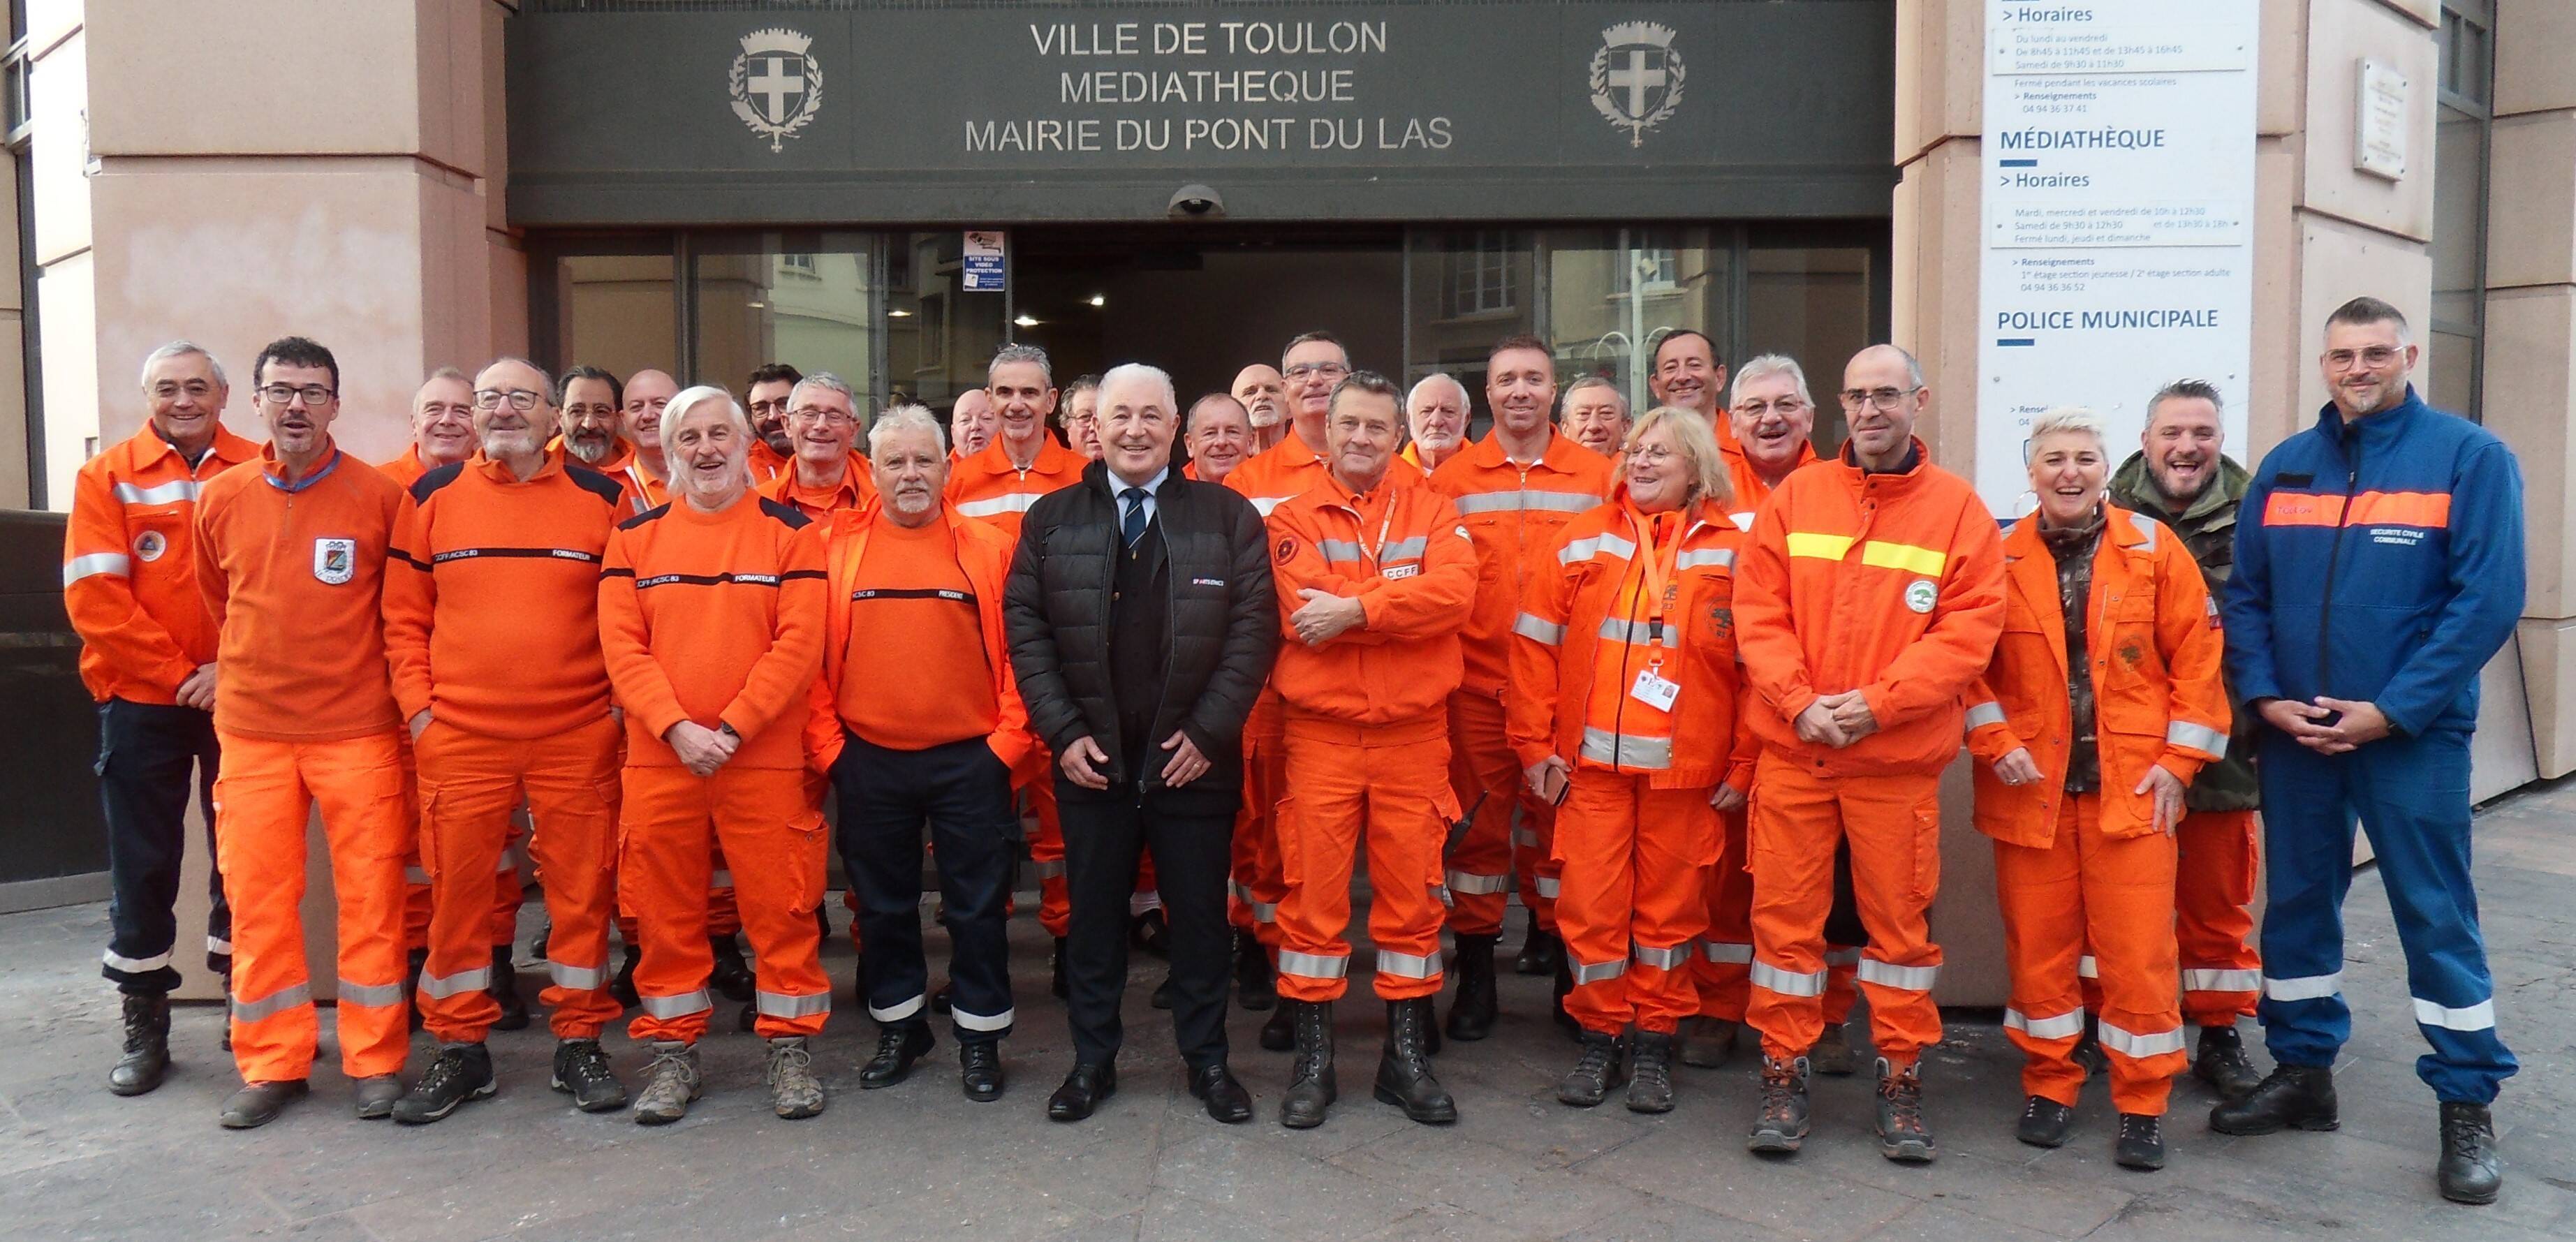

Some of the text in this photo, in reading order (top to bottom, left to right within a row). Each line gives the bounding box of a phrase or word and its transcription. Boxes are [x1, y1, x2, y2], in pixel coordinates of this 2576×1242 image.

[2019, 6, 2093, 22] Horaires
[1030, 22, 1386, 55] VILLE DE TOULON
[2016, 35, 2028, 43] Du
[2069, 34, 2107, 43] vendredi
[2105, 47, 2115, 55] de
[2118, 46, 2145, 54] 13h45
[2156, 45, 2183, 54] 16h45
[2016, 61, 2048, 69] Samedi
[2064, 60, 2086, 68] 9h30
[1061, 71, 1355, 103] MEDIATHEQUE
[2045, 79, 2081, 88] pendant
[2024, 92, 2096, 101] Renseignements
[966, 117, 1452, 151] MAIRIE DU PONT DU LAS
[2001, 126, 2165, 150] MÉDIATHÈQUE
[2017, 172, 2089, 187] Horaires
[2100, 208, 2136, 216] vendredi
[2140, 207, 2151, 216] de
[2154, 207, 2171, 216] 10h
[2180, 207, 2205, 216] 12h30
[2015, 221, 2047, 230] Samedi
[2096, 221, 2123, 229] 12h30
[2045, 235, 2069, 243] lundi,
[2072, 235, 2094, 244] jeudi
[2022, 258, 2095, 267] Renseignements
[2034, 271, 2057, 280] étage
[2060, 270, 2089, 279] section
[2091, 270, 2128, 280] jeunesse
[2147, 269, 2170, 279] étage
[2172, 269, 2201, 277] section
[2204, 267, 2230, 276] adulte
[1998, 310, 2218, 330] POLICE MUNICIPALE
[2402, 530, 2424, 538] CIVILE
[2373, 536, 2417, 546] COMMUNALE
[552, 549, 591, 561] FORMATEUR
[1387, 567, 1415, 578] CCFF
[735, 575, 776, 583] FORMATEUR
